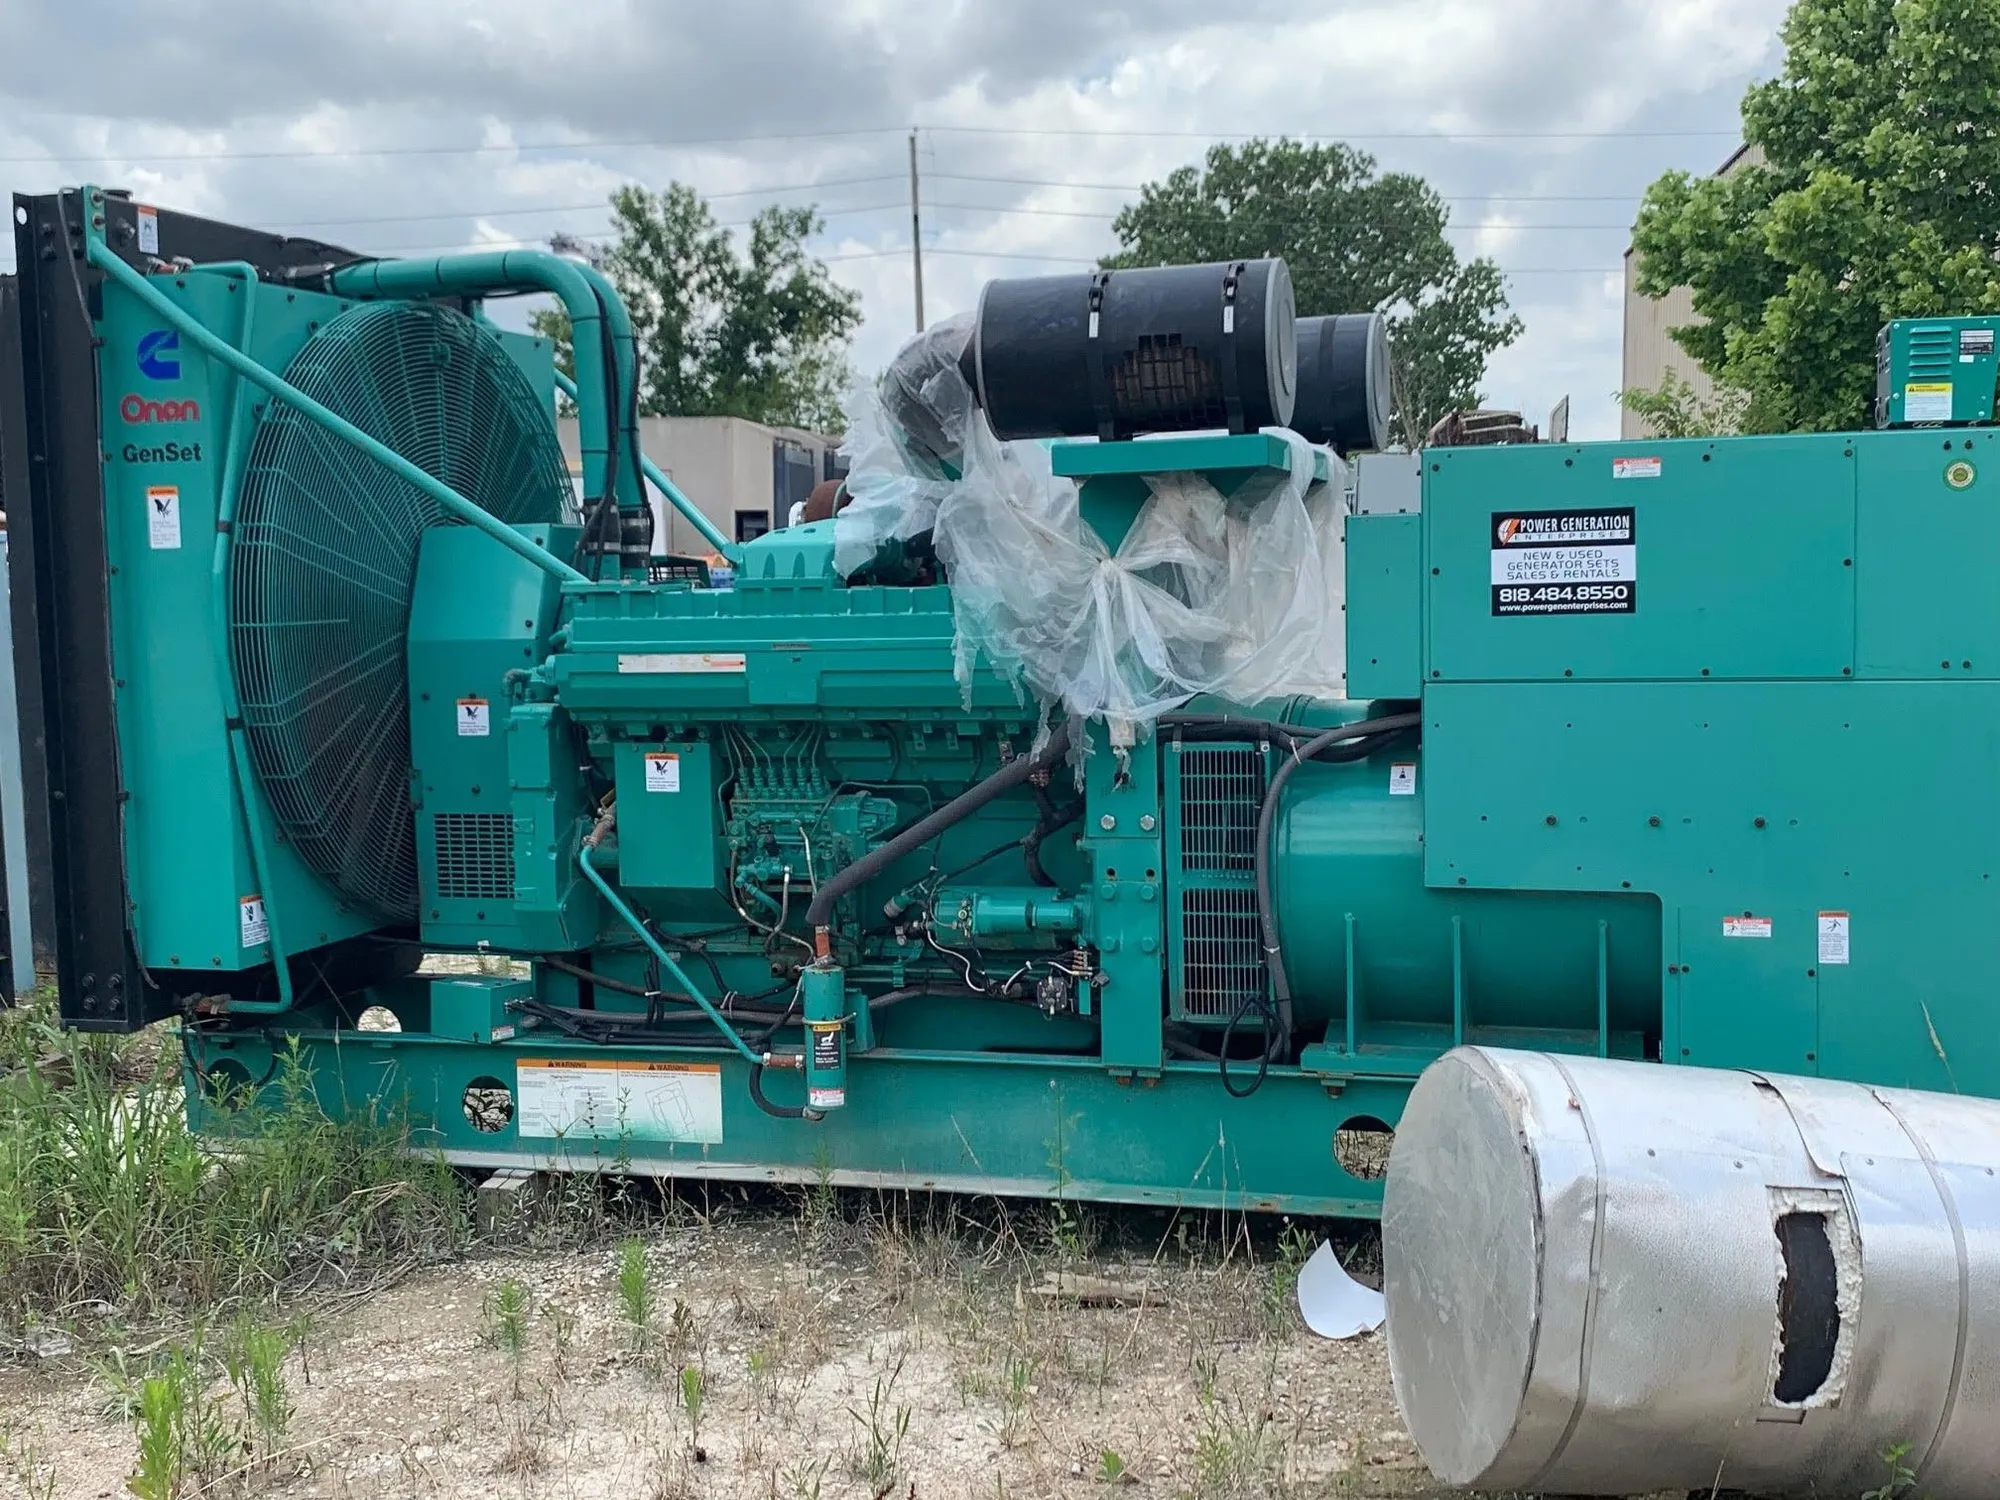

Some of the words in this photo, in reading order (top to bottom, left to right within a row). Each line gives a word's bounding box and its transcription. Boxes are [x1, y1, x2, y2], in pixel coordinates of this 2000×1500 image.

[123, 442, 202, 462] GenSet
[1520, 519, 1558, 533] POWER
[1560, 516, 1630, 531] GENERATION
[1514, 531, 1628, 541] ENTERPRISES
[1523, 551, 1551, 560] NEW
[1555, 550, 1564, 560] &
[1569, 549, 1603, 559] USED
[1507, 559, 1583, 571] GENERATOR
[1587, 559, 1619, 569] SETS
[1507, 571, 1546, 581] SALES
[1550, 570, 1559, 579] &
[1563, 569, 1620, 579] RENTALS
[1500, 586, 1628, 602] 818.484.8550
[1499, 602, 1628, 612] www.powergenenterprises.com
[555, 1061, 587, 1069] WARNING
